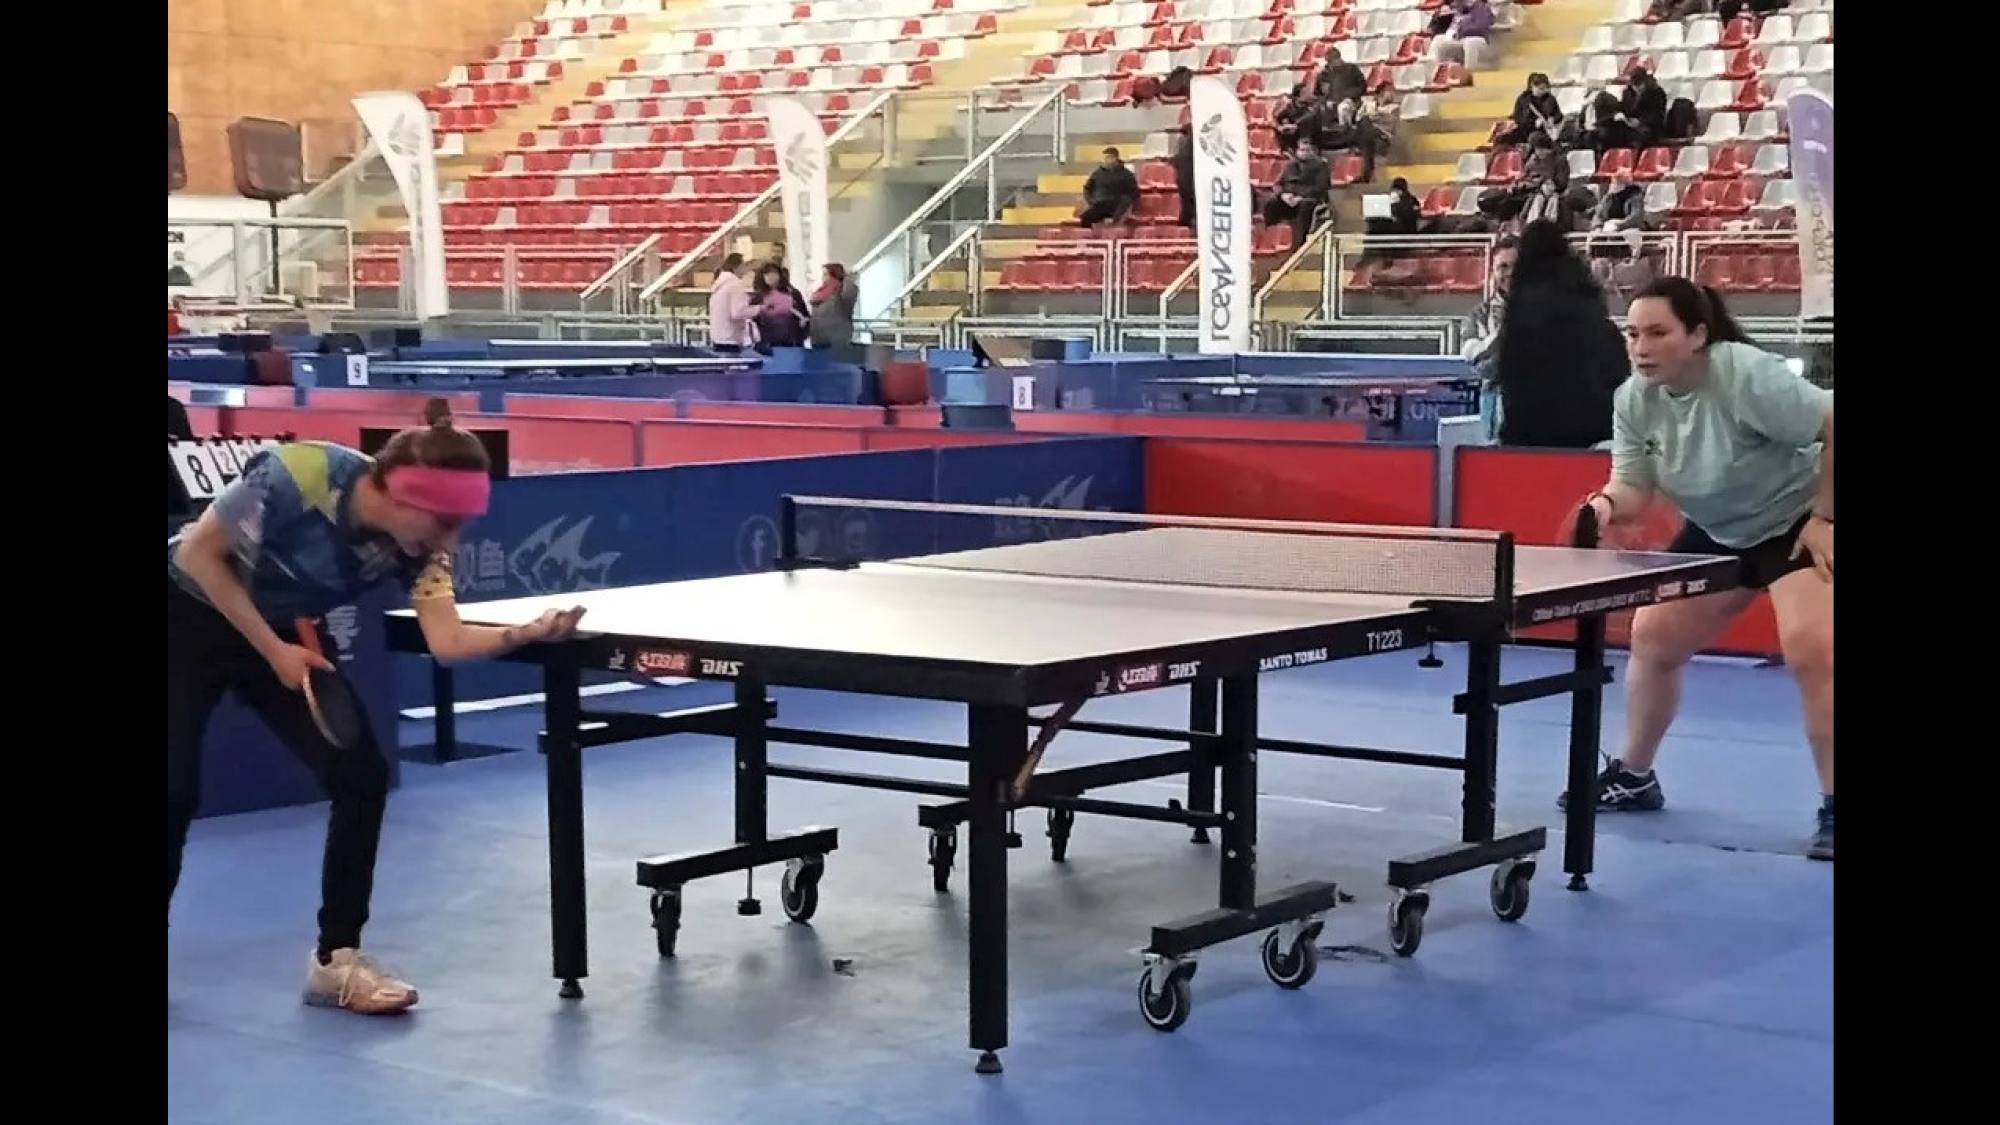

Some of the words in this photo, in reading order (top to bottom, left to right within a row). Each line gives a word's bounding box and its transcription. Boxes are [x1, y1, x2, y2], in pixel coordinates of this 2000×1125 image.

[186, 454, 213, 493] 8
[1366, 630, 1403, 652] T1223
[700, 658, 745, 677] DHS
[1259, 653, 1293, 671] SANTO
